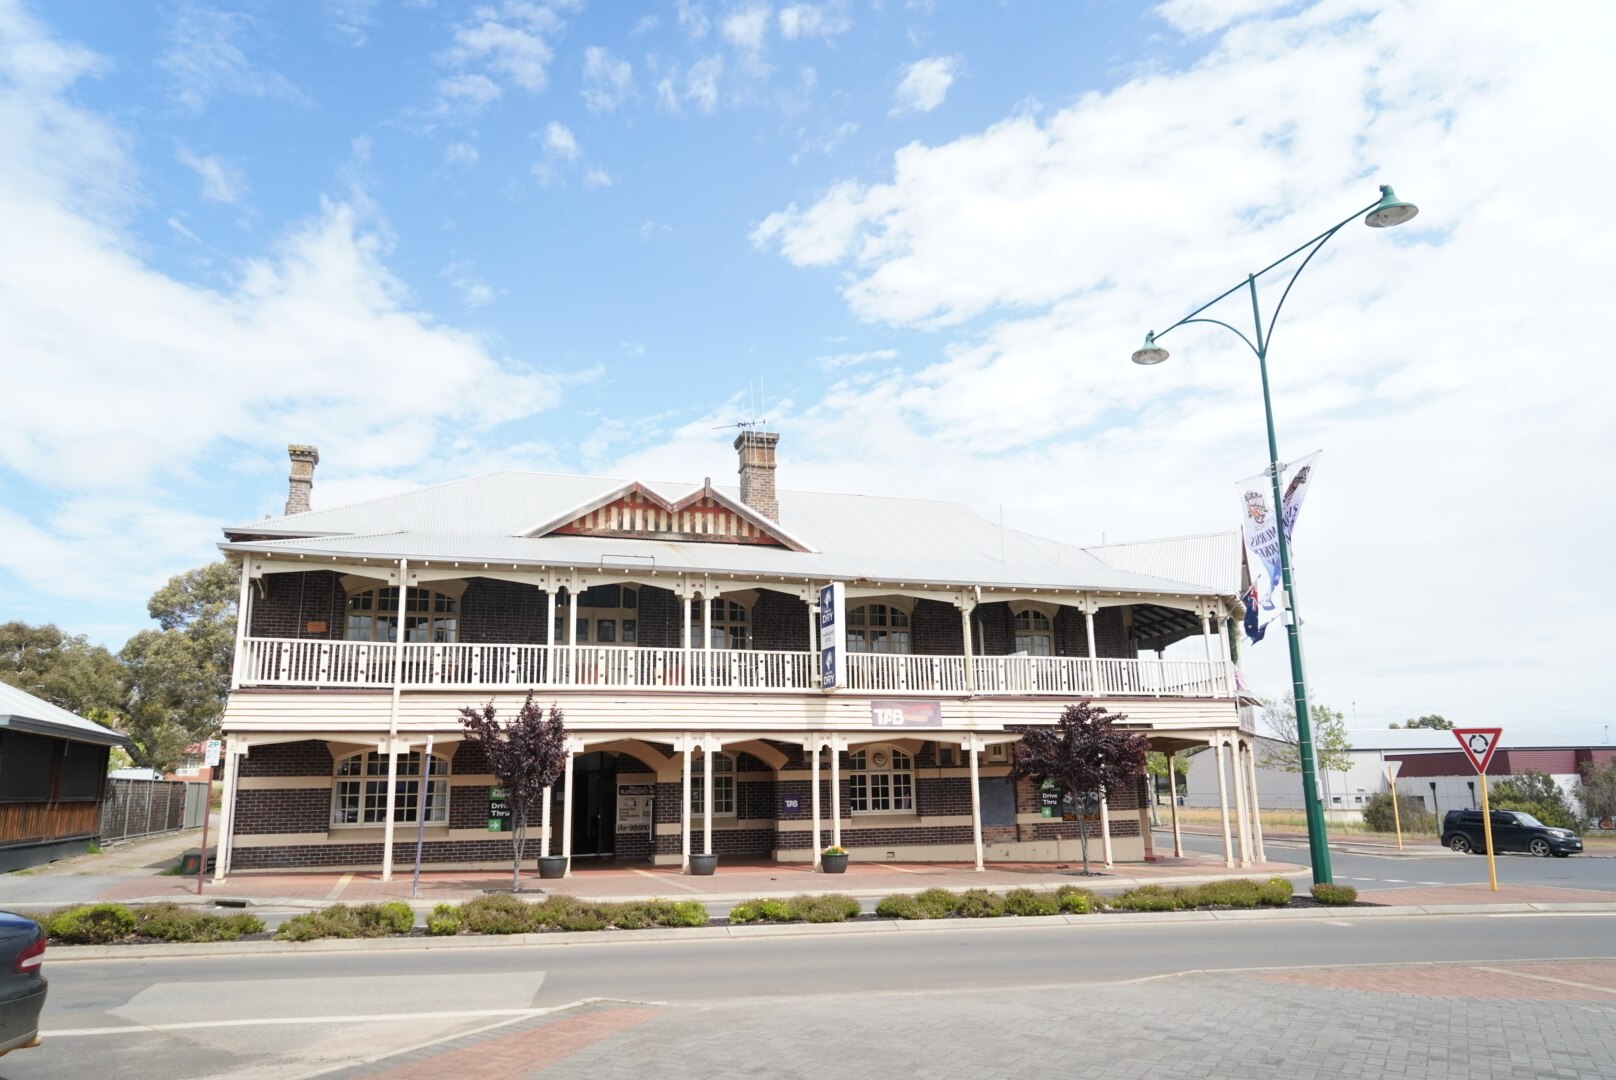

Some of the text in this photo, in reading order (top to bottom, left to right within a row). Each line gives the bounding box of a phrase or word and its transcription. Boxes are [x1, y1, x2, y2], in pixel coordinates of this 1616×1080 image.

[822, 611, 834, 624] DRY
[823, 673, 835, 686] DRY
[873, 708, 905, 726] TAB
[491, 802, 510, 810] Driv
[784, 800, 798, 808] TAB
